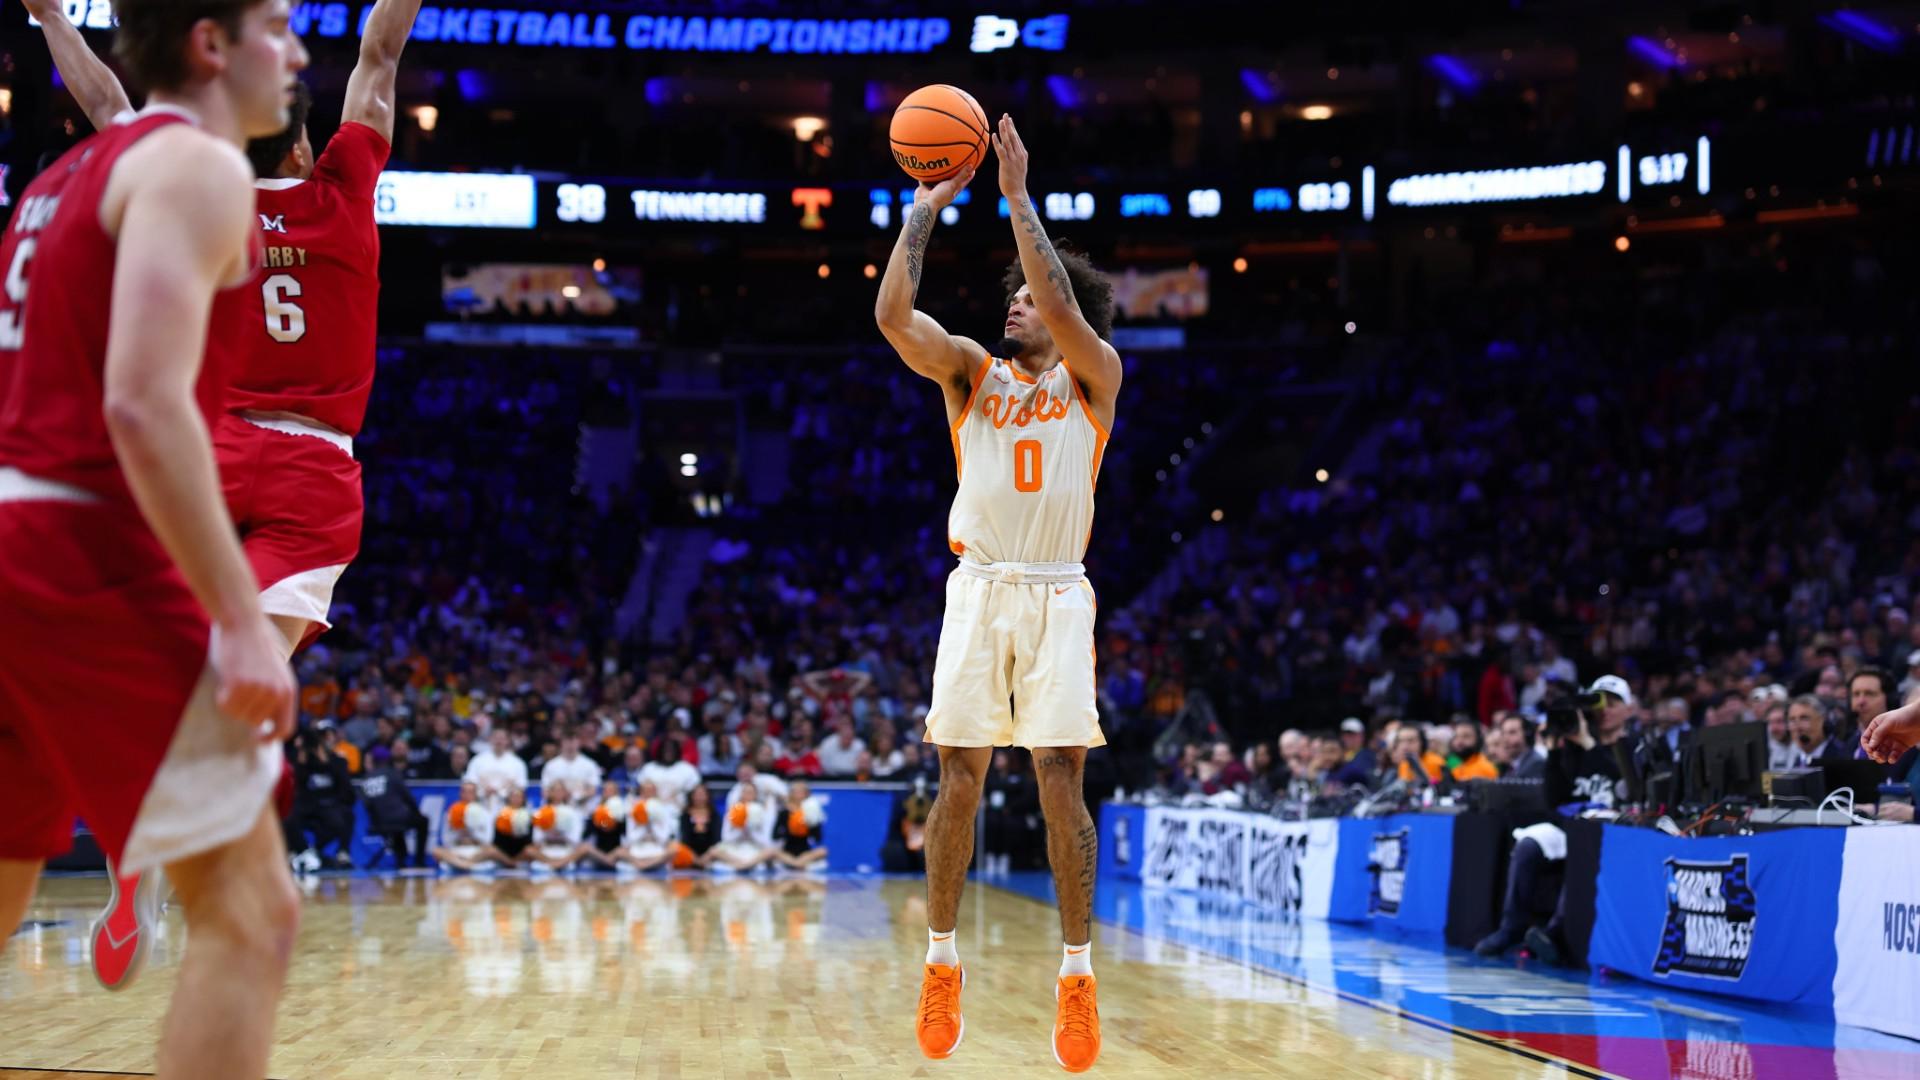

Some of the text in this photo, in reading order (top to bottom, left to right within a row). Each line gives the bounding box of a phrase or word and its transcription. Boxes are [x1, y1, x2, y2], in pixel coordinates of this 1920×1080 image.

[357, 6, 616, 48] SKETBALL
[624, 15, 951, 54] CHAMPIONSHIP
[893, 148, 950, 170] Wilson
[630, 190, 766, 223] TENNESSEE
[1387, 160, 1607, 207] #MARCHMADNESS
[258, 213, 288, 234] M
[262, 245, 306, 268] IRBY
[262, 273, 306, 343] 6
[981, 388, 1071, 430] Vols
[1013, 438, 1043, 493] 0
[1674, 868, 1727, 914] MARCH
[1683, 914, 1757, 960] MADNESS
